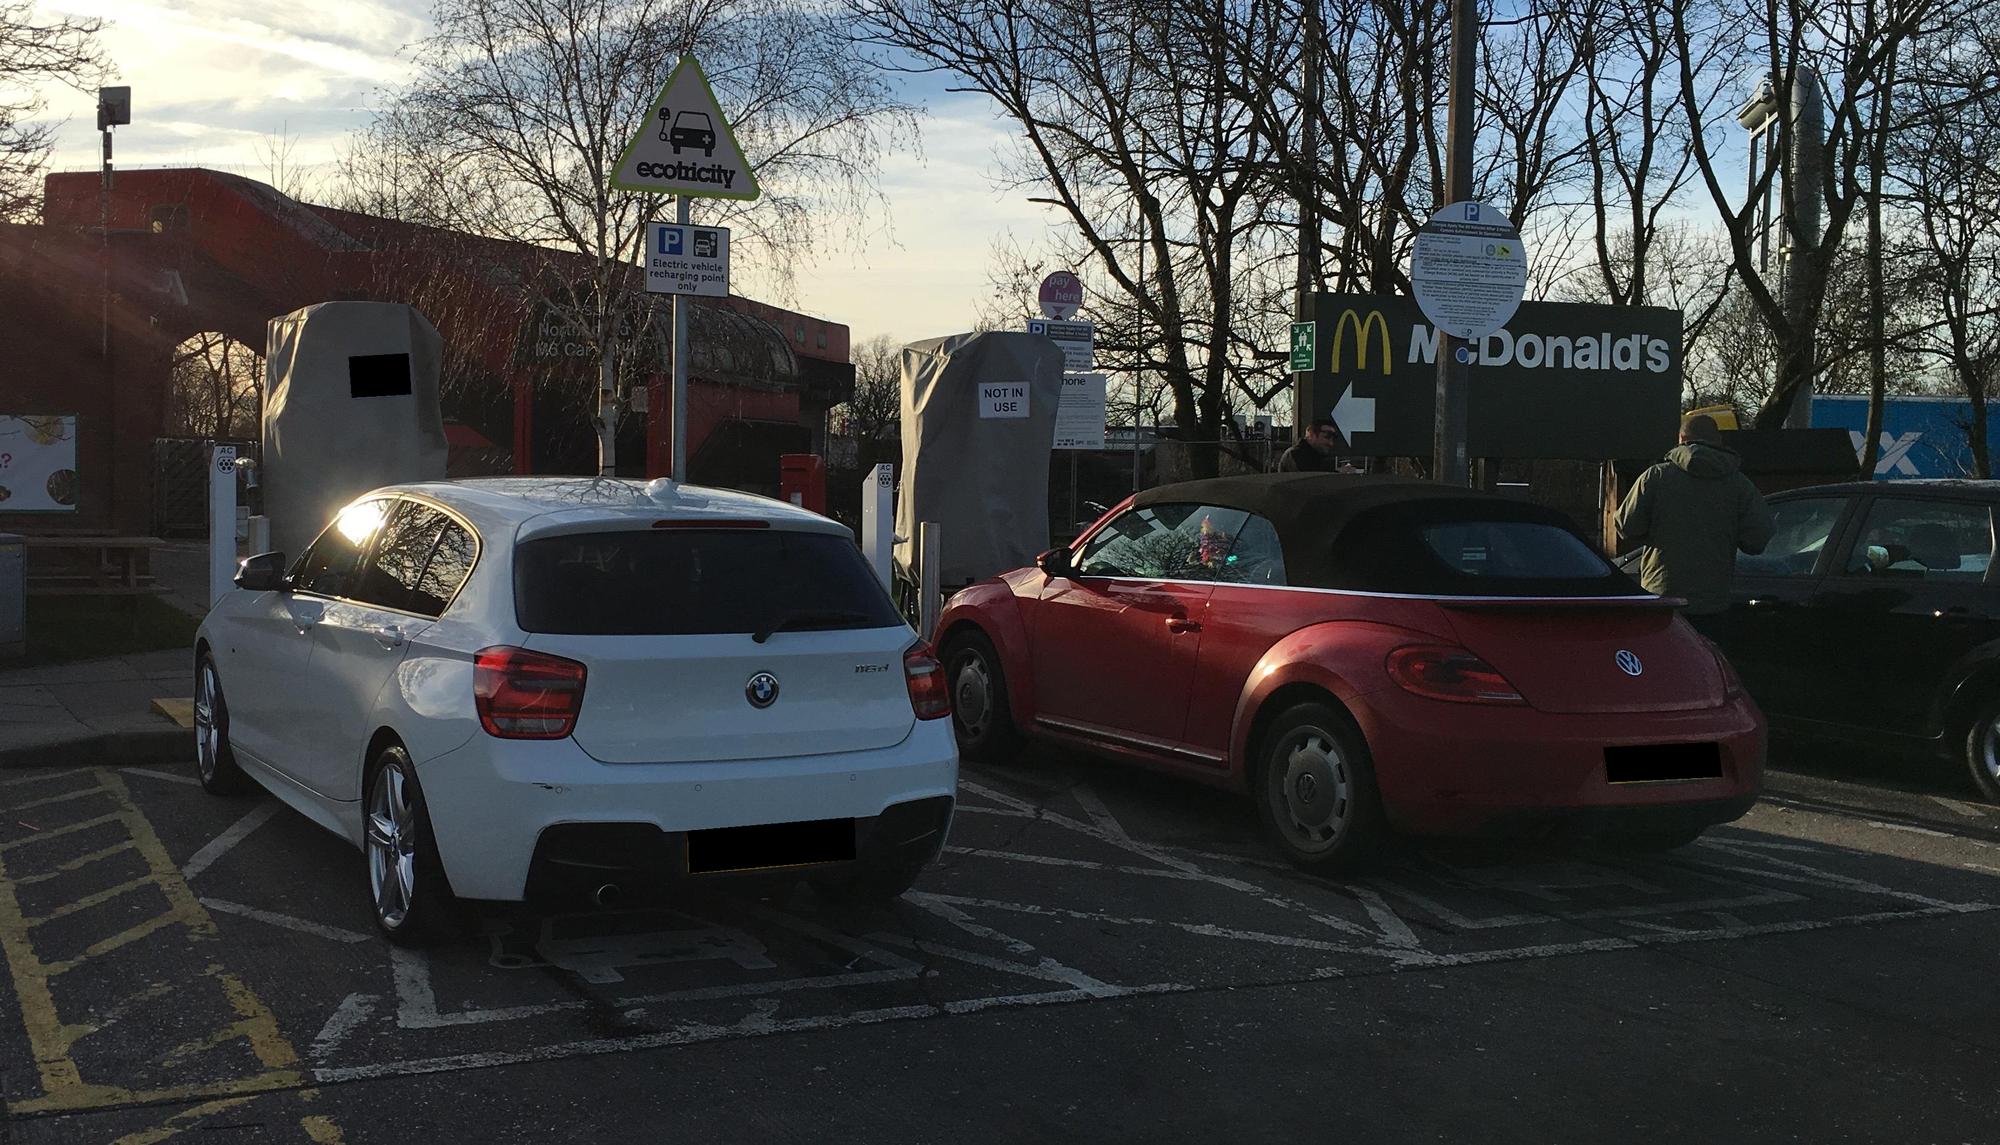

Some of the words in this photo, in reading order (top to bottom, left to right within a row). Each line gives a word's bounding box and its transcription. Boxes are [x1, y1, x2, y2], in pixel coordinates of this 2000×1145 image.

[636, 160, 736, 189] ecotricity
[1467, 205, 1478, 220] P
[664, 230, 680, 252] P
[653, 259, 688, 270] Electric
[691, 262, 723, 272] vehicle
[649, 270, 699, 282] recharging
[701, 273, 725, 283] point
[1049, 276, 1070, 289] pay
[677, 282, 698, 292] only
[1055, 289, 1080, 301] here
[1061, 376, 1086, 386] hone
[984, 388, 1008, 398] NOT
[1012, 387, 1024, 398] IN
[994, 402, 1017, 412] USE
